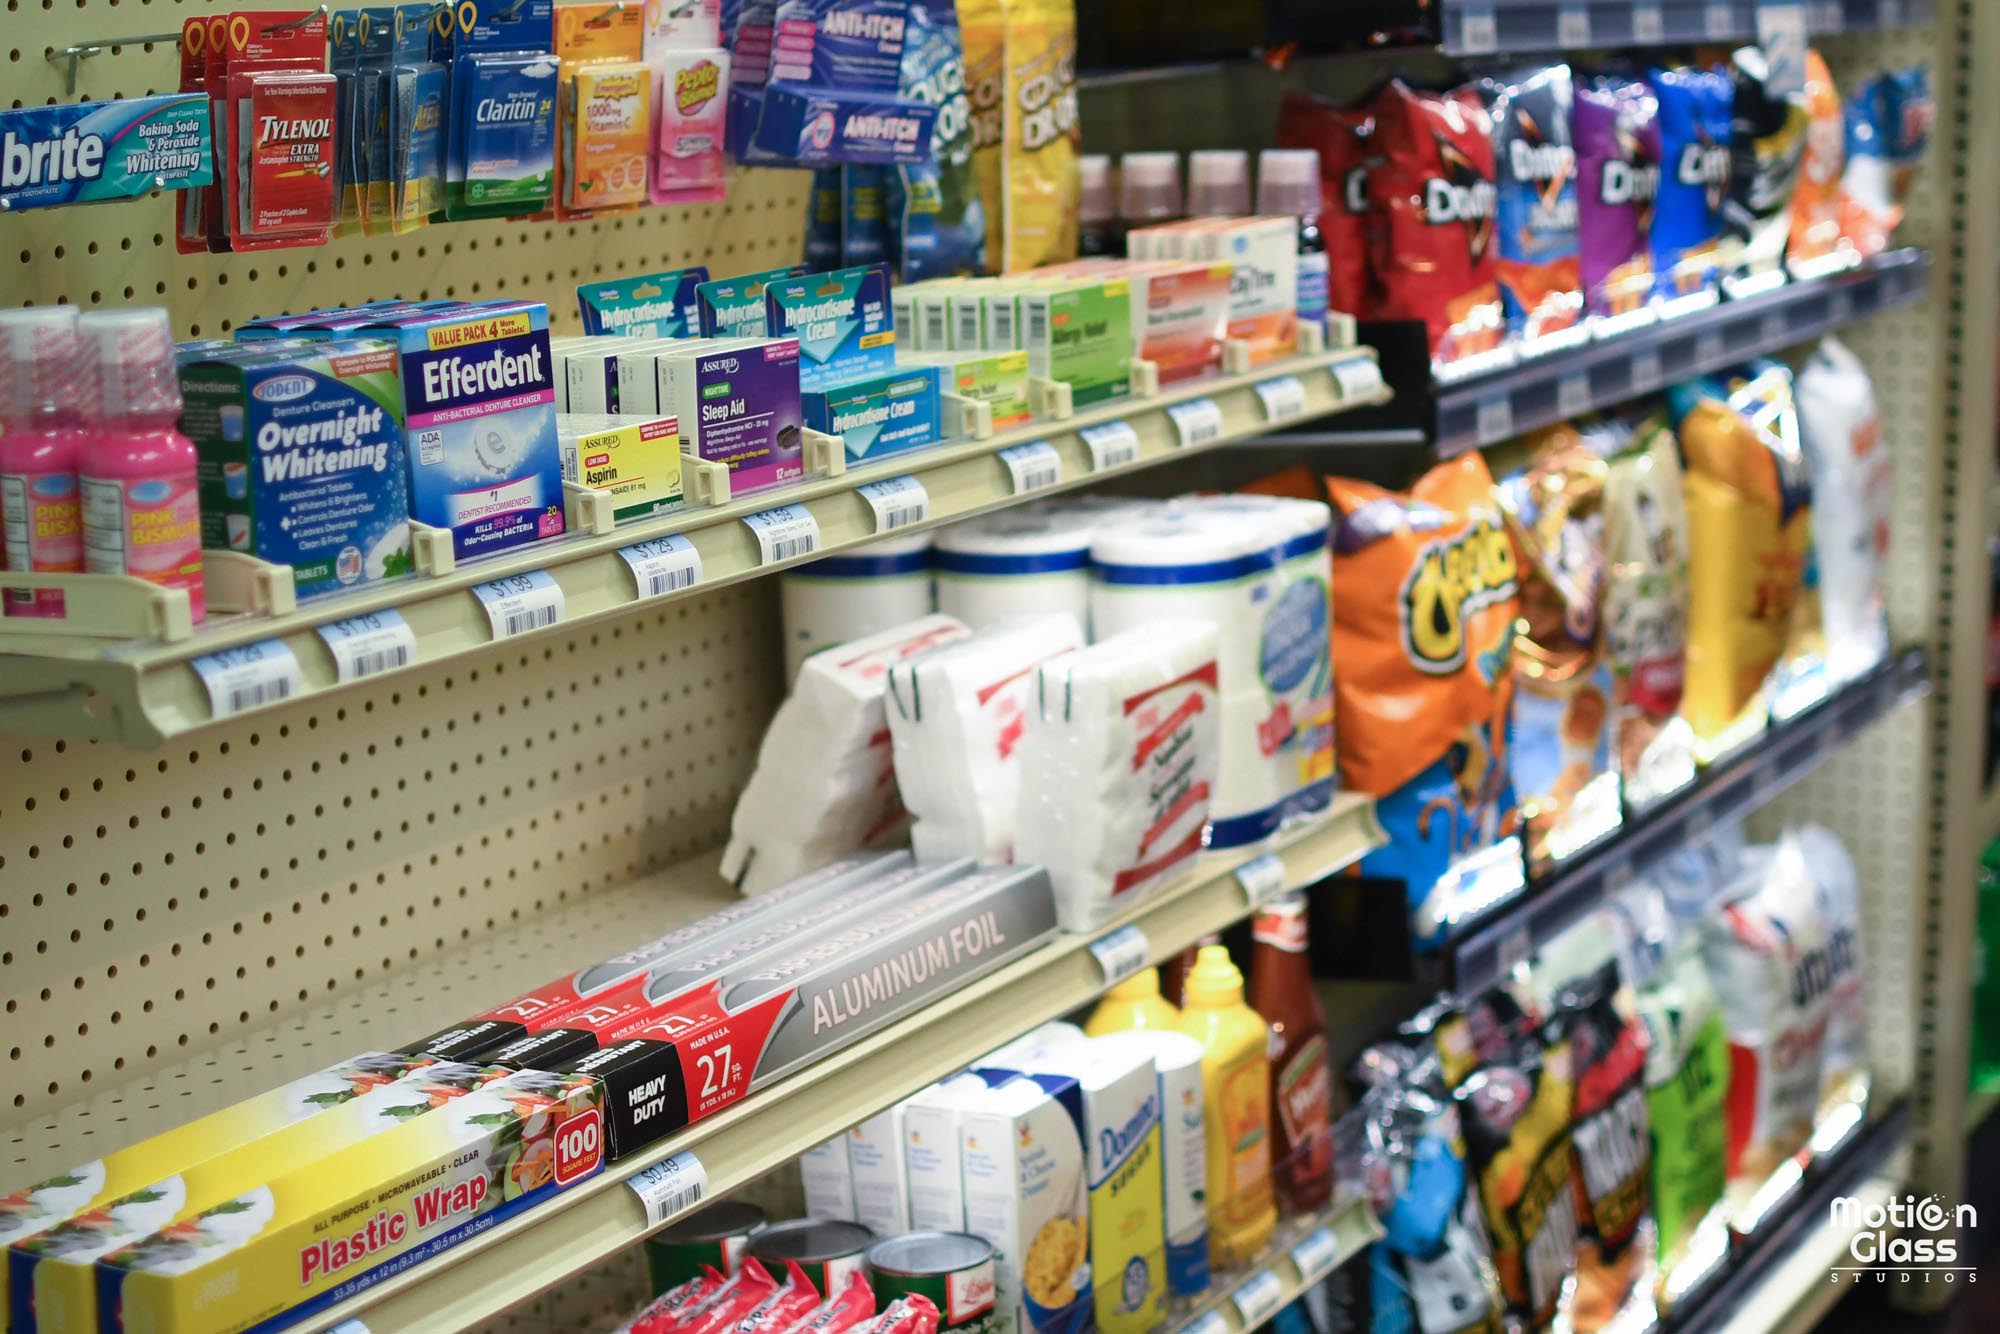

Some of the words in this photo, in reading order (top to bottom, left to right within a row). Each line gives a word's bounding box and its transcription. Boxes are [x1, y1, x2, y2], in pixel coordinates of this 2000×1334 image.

[822, 10, 905, 41] ANTI-ITCH
[476, 98, 536, 122] Claritin
[139, 122, 173, 138] Baking
[175, 120, 199, 133] Soda
[260, 115, 330, 142] TYLENOL
[843, 114, 921, 141] ANTI-ITCH
[149, 138, 156, 150] &
[157, 134, 200, 150] Peroxide
[290, 143, 319, 155] EXTRA
[2, 126, 104, 187] brite
[127, 151, 200, 174] Whitening
[289, 154, 319, 163] STRENGTH
[21, 187, 59, 197] TOOTHPASTE
[600, 301, 675, 331] Hydrocortisone
[785, 298, 856, 329] Hydrocortisone
[432, 328, 462, 346] VALUE
[463, 324, 487, 342] PACK
[489, 321, 499, 338] 4
[501, 325, 525, 336] Tablets!
[626, 322, 658, 337] Cream
[806, 320, 837, 342] Cream
[423, 344, 544, 403] Efferdent
[701, 357, 740, 374] ASSURED
[181, 380, 241, 395] Directions:
[704, 384, 730, 396] NIGHTTIME
[272, 405, 311, 418] Denture
[311, 397, 356, 412] Cleansers
[433, 407, 484, 422] ANTI-BACTERIAL
[484, 400, 511, 413] DENTURE
[512, 394, 541, 407] CLEANSER
[702, 402, 730, 421] Sleep
[730, 398, 745, 415] Aid
[833, 404, 890, 433] Hydrocortisone
[889, 400, 916, 418] Cream
[257, 405, 383, 451] Overnight
[421, 432, 440, 444] ADA
[584, 435, 621, 450] ASSURED
[262, 439, 389, 484] Whitening
[587, 456, 597, 466] LOW
[597, 455, 608, 464] DOSE
[586, 466, 618, 486] Aspirin
[776, 467, 784, 480] 12
[630, 483, 637, 491] 81
[637, 482, 646, 492] mg
[297, 500, 327, 511] Whitens
[298, 512, 328, 525] Controls
[328, 507, 357, 517] Denture
[358, 503, 376, 513] Odor
[458, 506, 484, 520] DENTIST
[484, 495, 532, 513] RECOMMENDED
[547, 505, 558, 517] 20
[653, 502, 660, 513] 60
[131, 510, 174, 529] PINK
[475, 521, 493, 534] KILLS
[493, 514, 515, 529] 99.9%
[515, 515, 523, 524] of
[757, 508, 794, 525] $1.59
[298, 527, 325, 538] Leaves
[325, 520, 358, 532] Dentures
[464, 530, 503, 546] Odor-Causing
[503, 522, 534, 536] BACTERIA
[541, 522, 563, 534] TABLETS
[299, 540, 321, 551] Clean
[326, 534, 348, 545] Fresh
[638, 540, 674, 559] $1.29
[295, 565, 328, 580] TABLETS
[488, 576, 533, 599] $1.99
[812, 935, 947, 1037] ALUMINUM
[952, 911, 1006, 965] FOIL
[496, 998, 547, 1016] 27
[566, 1005, 619, 1024] 27
[642, 1015, 696, 1035] 27
[426, 1021, 498, 1054] RESISTANT
[497, 1029, 568, 1060] RESISTANT
[689, 1035, 708, 1050] MADE
[707, 1032, 714, 1042] IN
[713, 1026, 731, 1039] U.S.A.
[575, 1039, 647, 1074] RESISTANT
[696, 1044, 732, 1098] 27
[731, 1062, 742, 1073] SQ.
[732, 1072, 743, 1083] FT.
[628, 1074, 667, 1107] HEAVY
[706, 1098, 718, 1109] YDS.
[726, 1088, 736, 1099] IN.)
[634, 1096, 666, 1126] DUTY
[559, 1123, 598, 1164] 100
[562, 1159, 583, 1175] SQUARE
[583, 1152, 597, 1165] FEET
[641, 1158, 680, 1186] $0.49
[313, 1219, 329, 1233] ALL
[331, 1200, 370, 1226] PURPOSE
[377, 1164, 447, 1203] MICROWAVEABLE
[453, 1149, 480, 1169] CLEAR
[300, 1211, 406, 1285] Plastic
[413, 1173, 488, 1229] Wrap
[356, 1275, 371, 1291] yds
[372, 1273, 378, 1282] x
[379, 1267, 389, 1279] 12
[389, 1262, 398, 1274] in
[398, 1253, 415, 1272] (9.3
[431, 1238, 449, 1253] 30.5
[449, 1235, 458, 1245] m
[464, 1214, 495, 1237] 30.5cm)
